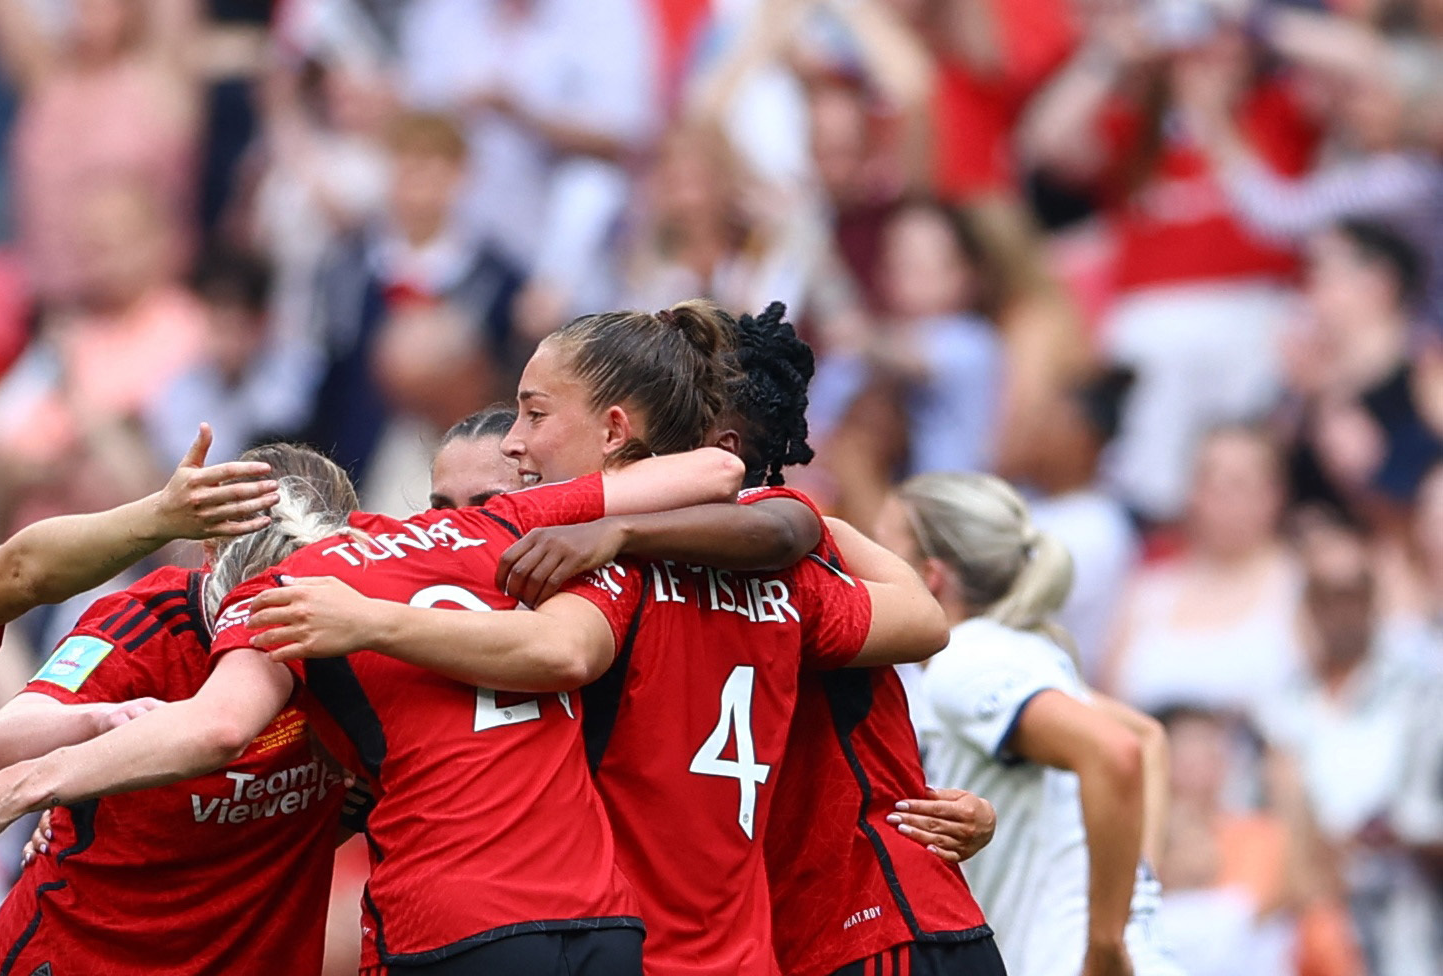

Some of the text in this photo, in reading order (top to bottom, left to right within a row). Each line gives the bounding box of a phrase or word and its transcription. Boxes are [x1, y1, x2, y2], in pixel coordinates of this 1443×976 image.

[650, 559, 686, 604] LE
[689, 665, 771, 841] 4
[226, 761, 318, 802] Team
[191, 786, 317, 824] Viewer
